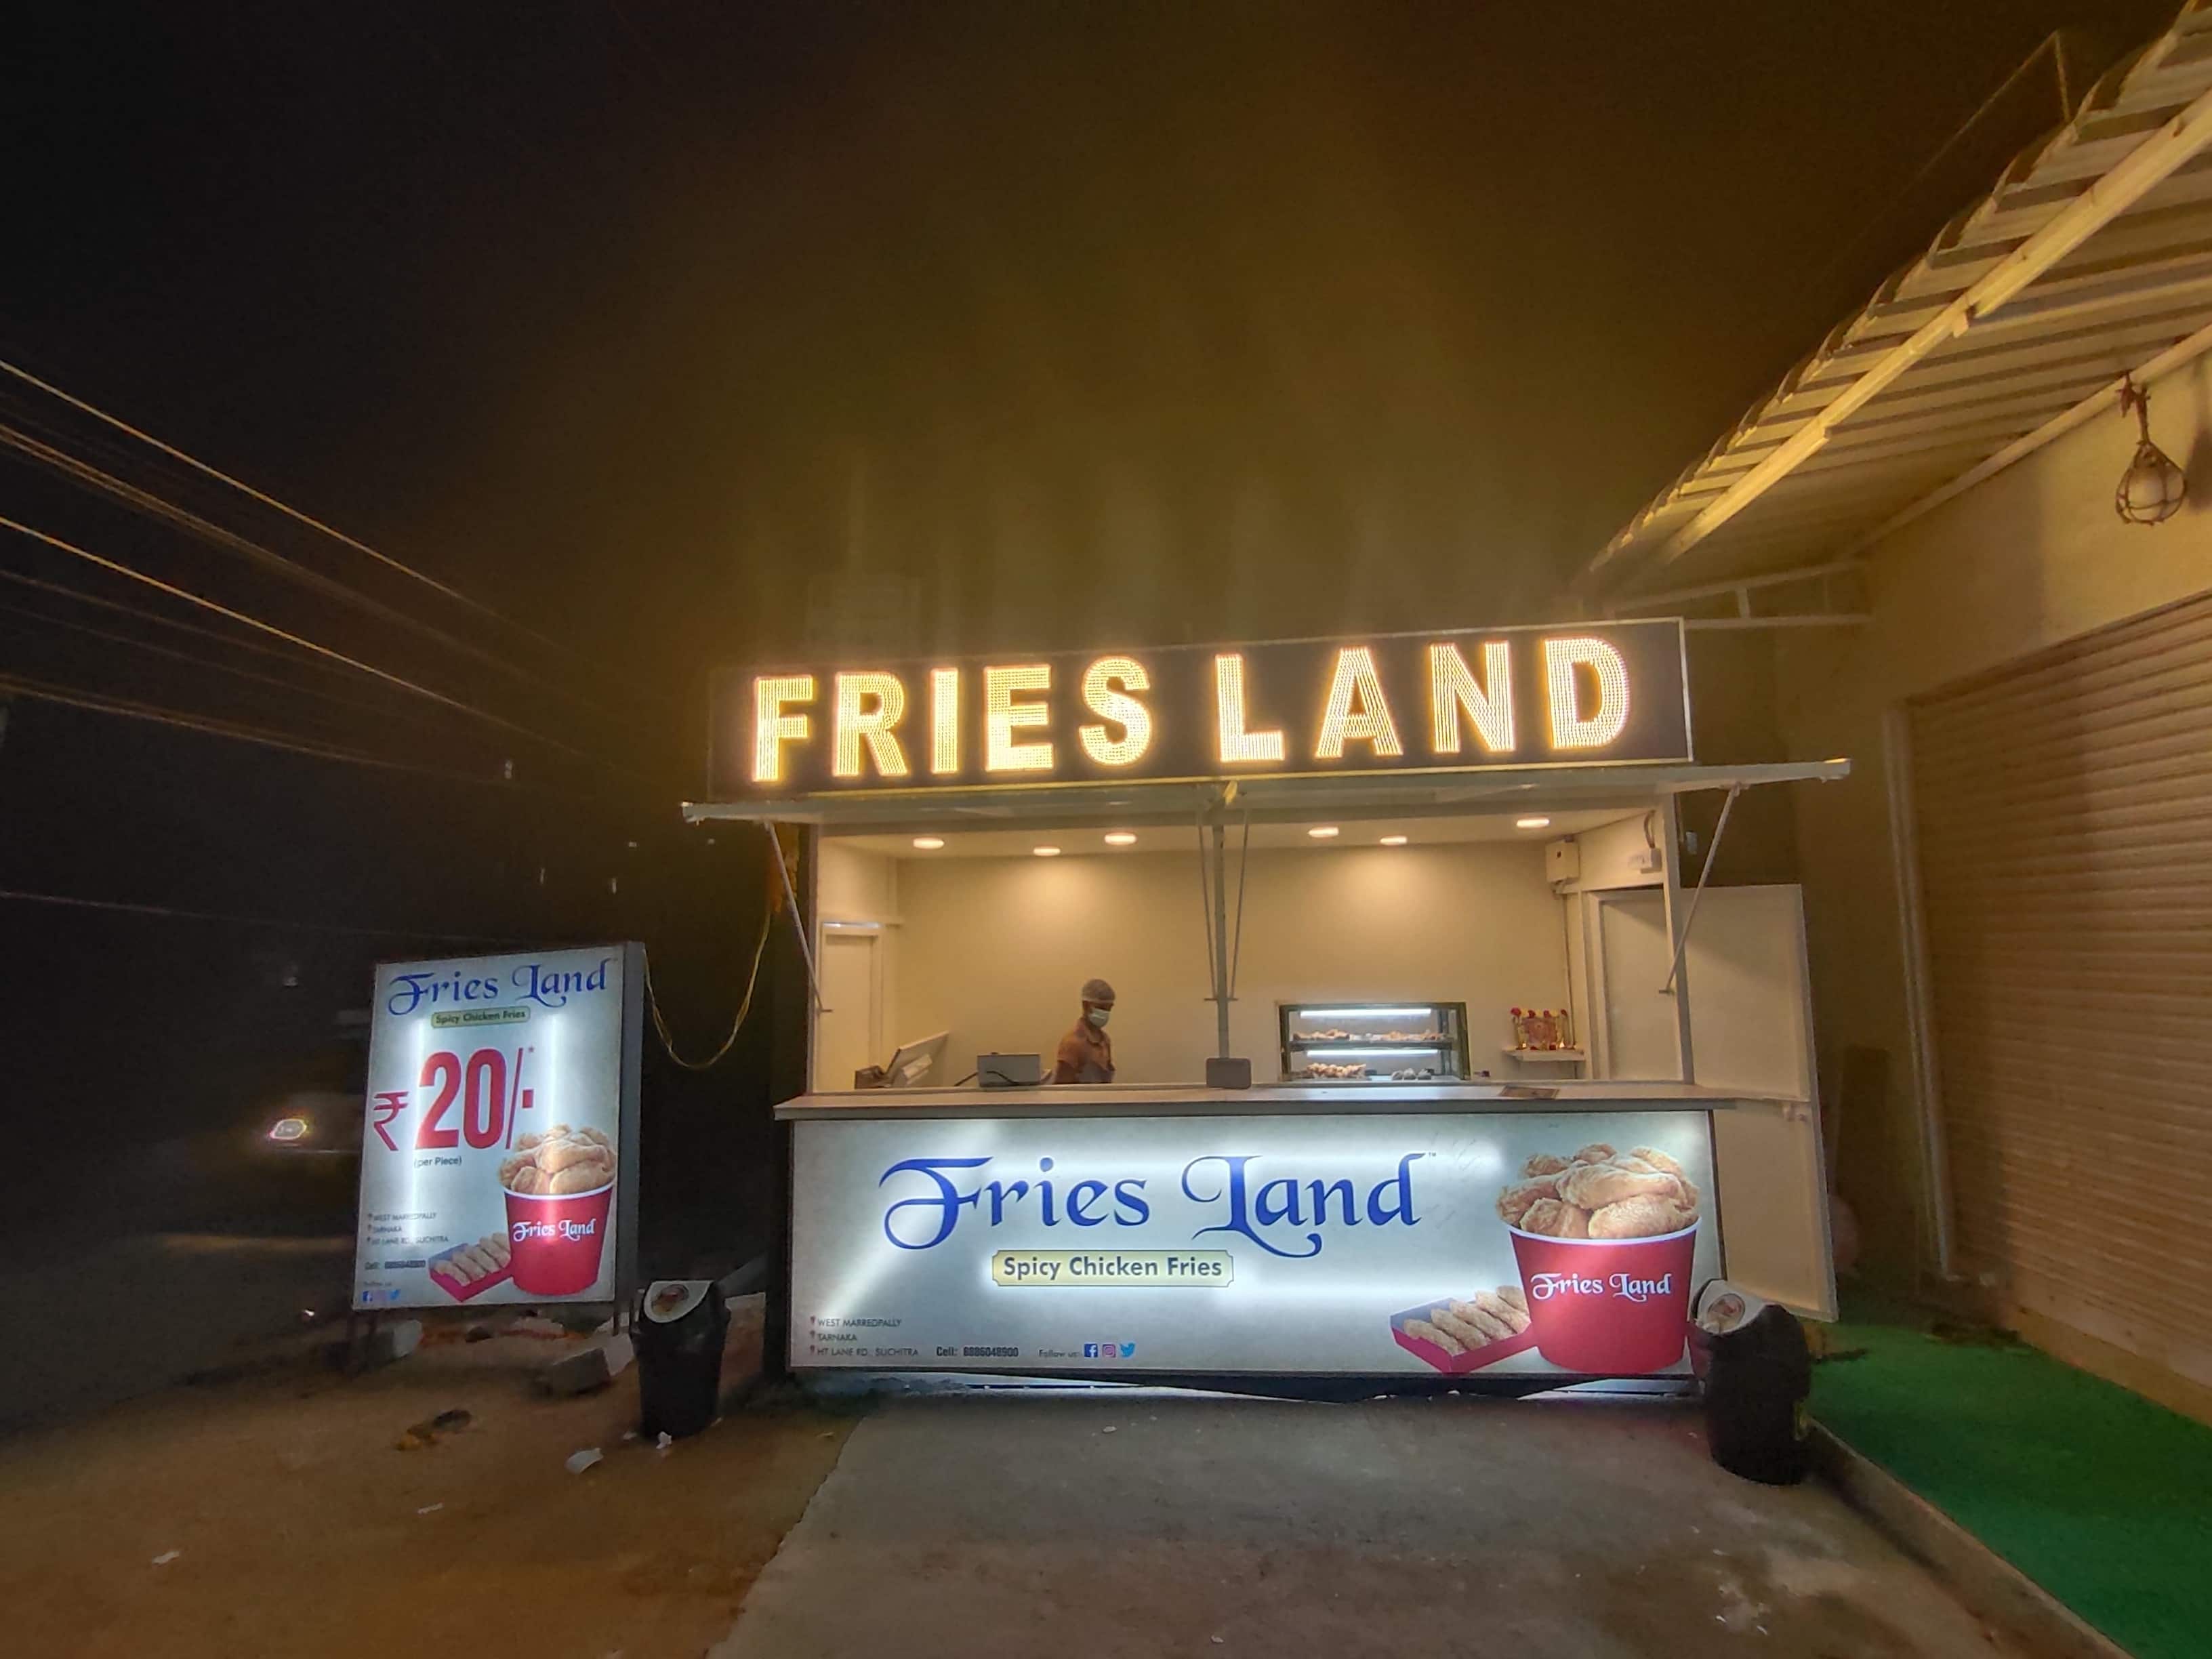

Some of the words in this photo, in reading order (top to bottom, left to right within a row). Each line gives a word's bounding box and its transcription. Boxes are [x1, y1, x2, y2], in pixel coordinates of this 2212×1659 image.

[751, 656, 1151, 783] FRIES
[1214, 637, 1631, 762] LAND
[388, 970, 499, 1016] Fries
[511, 958, 612, 1008] Land
[436, 1014, 460, 1025] Spicy
[463, 1010, 500, 1021] Chicken
[503, 1010, 526, 1019] Fries
[878, 1155, 1151, 1250] Fries
[1181, 1152, 1426, 1258] Land
[512, 1221, 556, 1242] Fries
[558, 1218, 597, 1242] Land
[1003, 1256, 1061, 1280] Spicy
[1069, 1256, 1158, 1276] Chicken
[1166, 1256, 1223, 1276] Fries
[1530, 1273, 1604, 1300] Fries
[1608, 1273, 1673, 1303] Land
[817, 1318, 841, 1327] WEST
[817, 1333, 857, 1341] TARNAKA
[831, 1347, 854, 1356] LANE
[875, 1347, 919, 1356] SUCHITRA
[936, 1346, 958, 1356] Cell:
[1038, 1349, 1065, 1357] Follow
